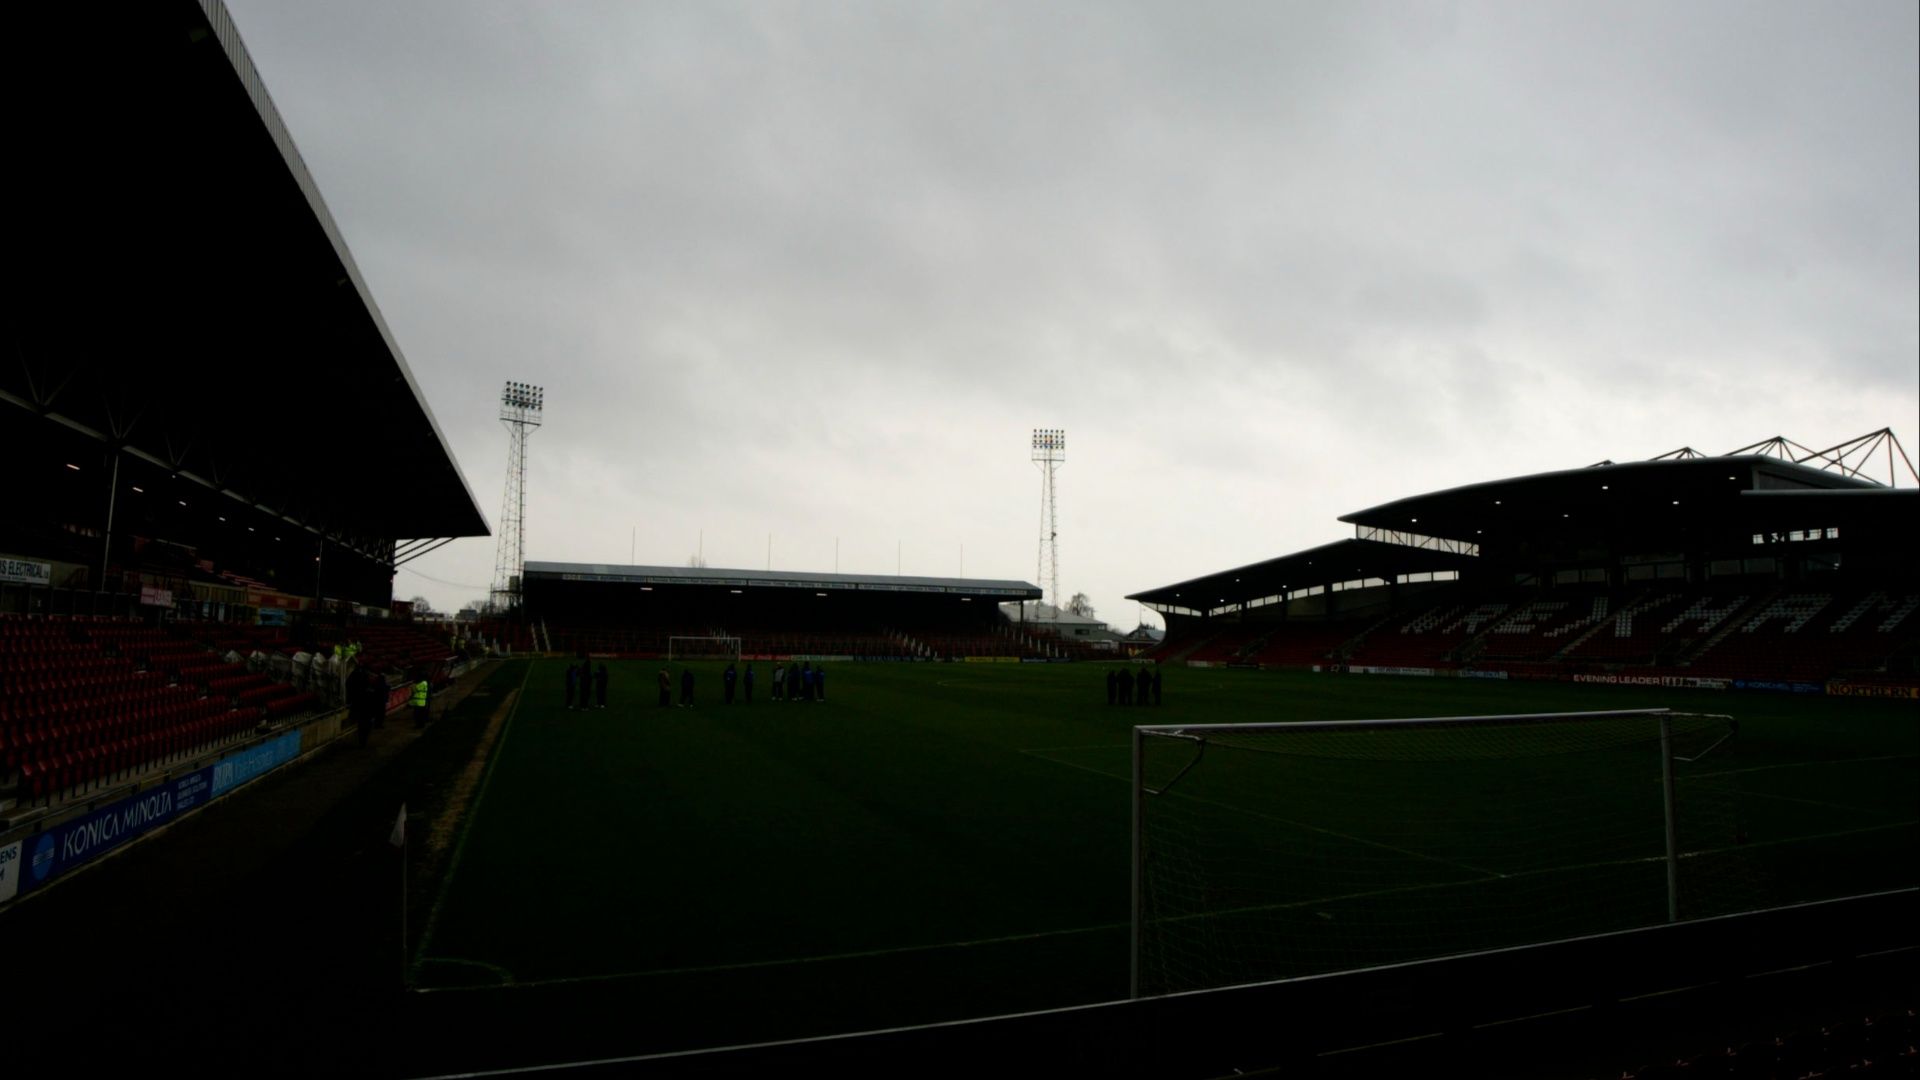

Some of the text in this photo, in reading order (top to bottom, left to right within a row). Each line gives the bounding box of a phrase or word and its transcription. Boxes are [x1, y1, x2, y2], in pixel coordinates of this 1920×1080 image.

[8, 561, 43, 578] ELECTRICAL
[1573, 673, 1662, 686] EVENING LEADER
[1829, 684, 1911, 698] NORTHERN
[62, 813, 119, 862] KONICA
[121, 791, 172, 833] MINOLTA
